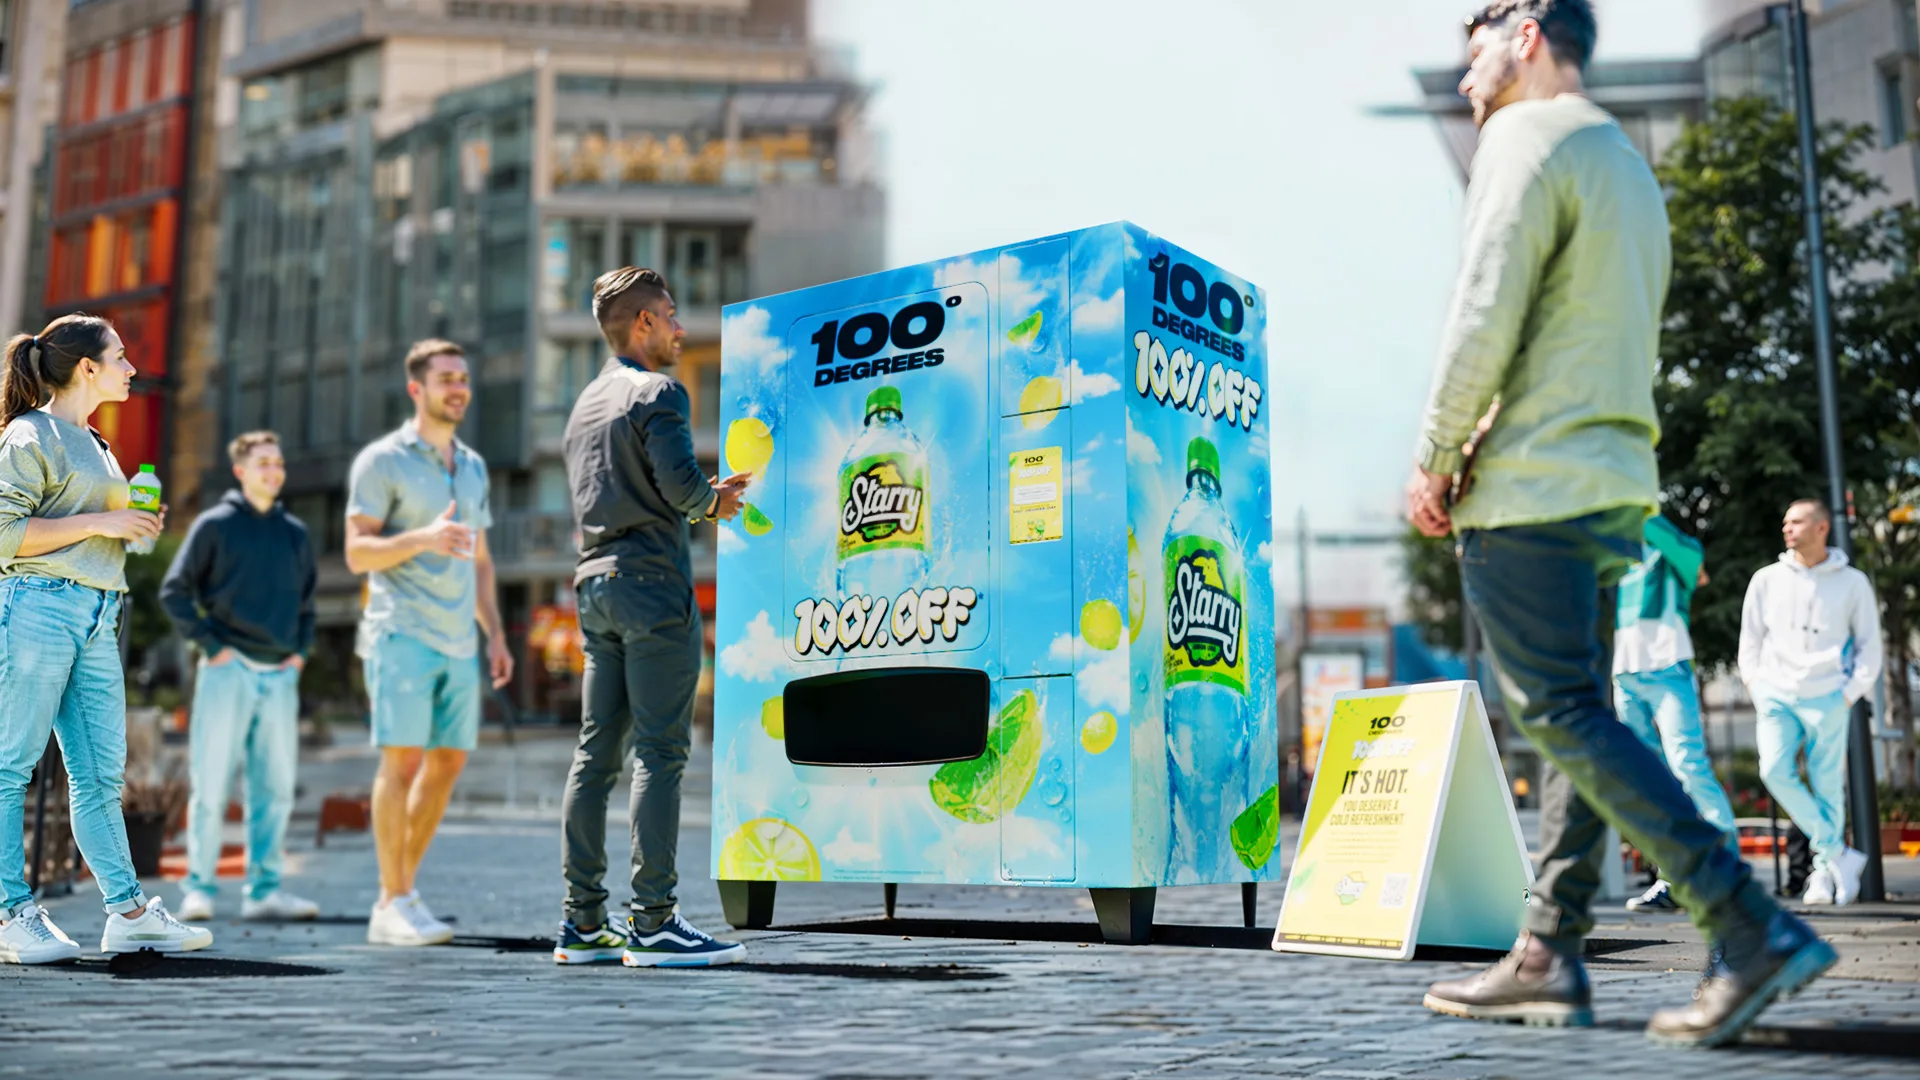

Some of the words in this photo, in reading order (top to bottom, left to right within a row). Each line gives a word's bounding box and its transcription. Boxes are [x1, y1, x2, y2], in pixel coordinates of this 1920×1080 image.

[1152, 305, 1245, 363] DEGREES
[814, 348, 945, 387] DEGREES
[1133, 330, 1207, 417] 100%
[1207, 362, 1262, 433] OFF
[842, 475, 922, 533] Starry
[793, 594, 890, 656] 100%
[1168, 562, 1241, 663] Starry
[1341, 769, 1373, 794] IT'S
[1374, 768, 1408, 794] HOT.
[1343, 799, 1358, 812] YOU
[1359, 798, 1392, 812] DESERVE
[1330, 813, 1350, 826] COLD
[1350, 812, 1405, 826] REFRESHMENT
